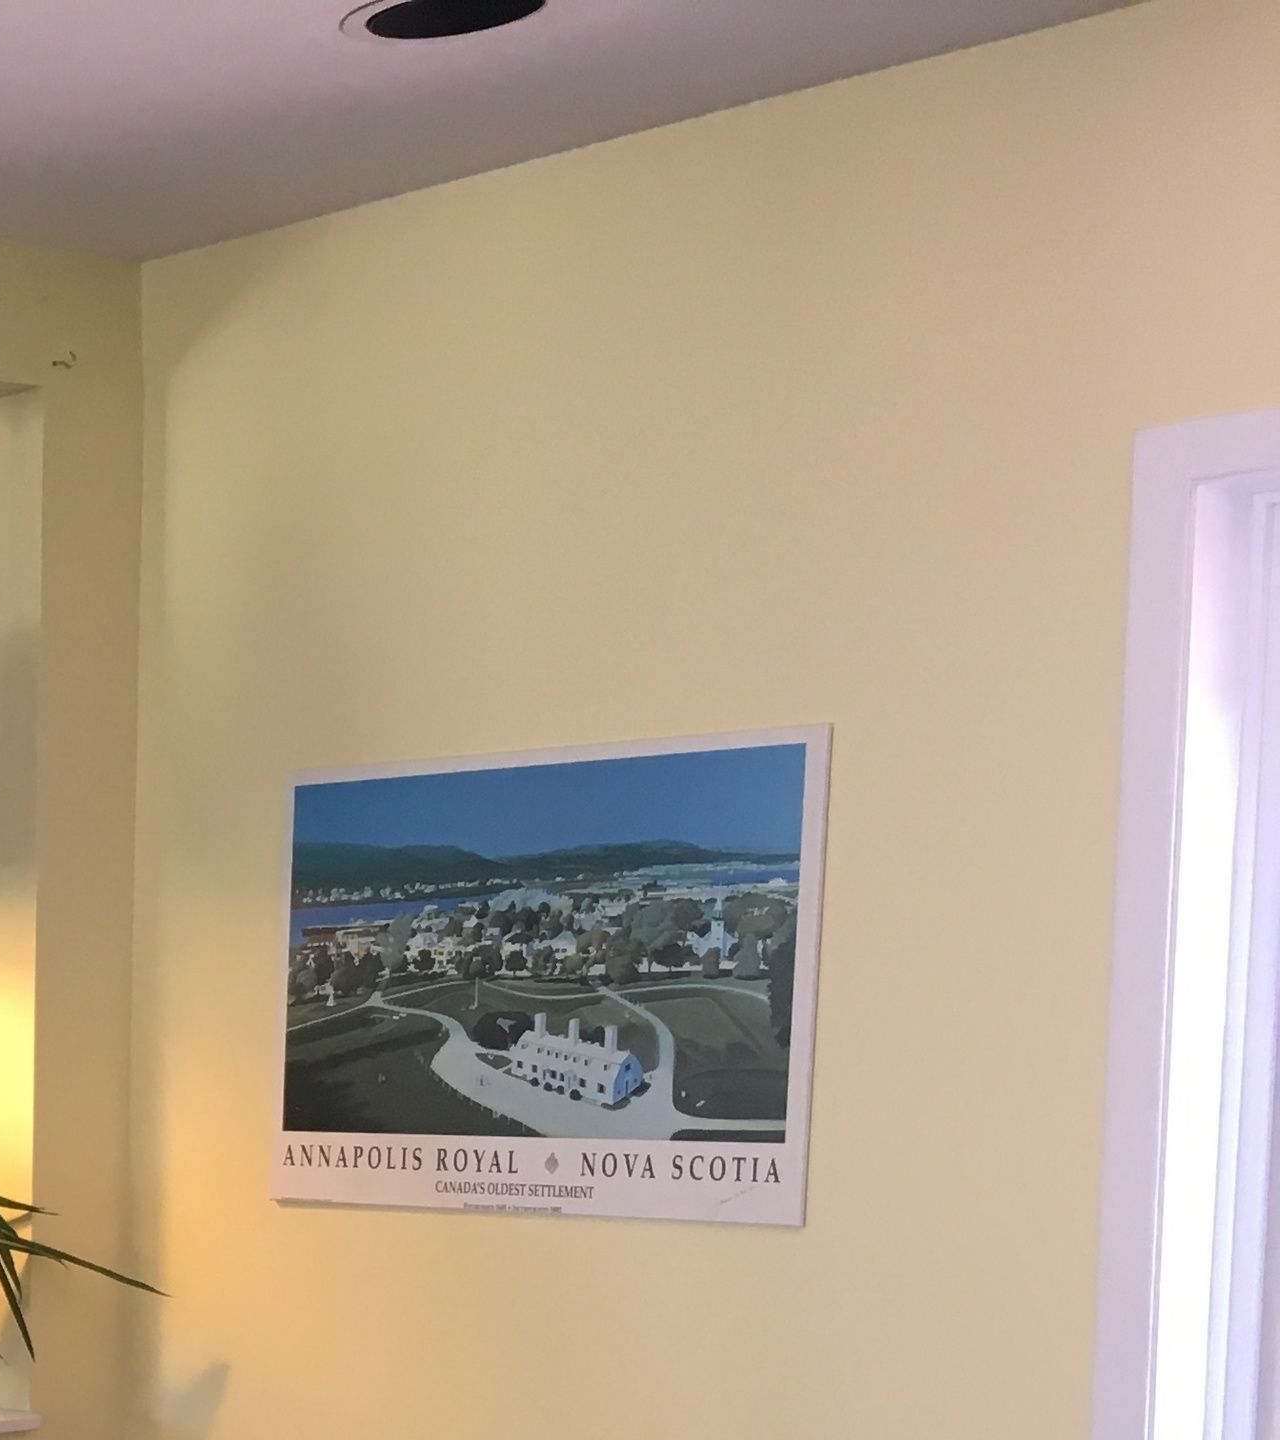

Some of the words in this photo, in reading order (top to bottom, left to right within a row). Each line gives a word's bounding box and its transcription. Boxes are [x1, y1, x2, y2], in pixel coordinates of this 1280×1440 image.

[283, 1144, 423, 1171] ANNAPOLIS
[436, 1148, 519, 1174] ROYAL
[580, 1152, 656, 1179] NOVA
[671, 1154, 781, 1183] SCOTIA
[435, 1180, 486, 1194] CANADA'S
[487, 1182, 527, 1197] OLDEST
[528, 1184, 595, 1199] SETTLEMENT
